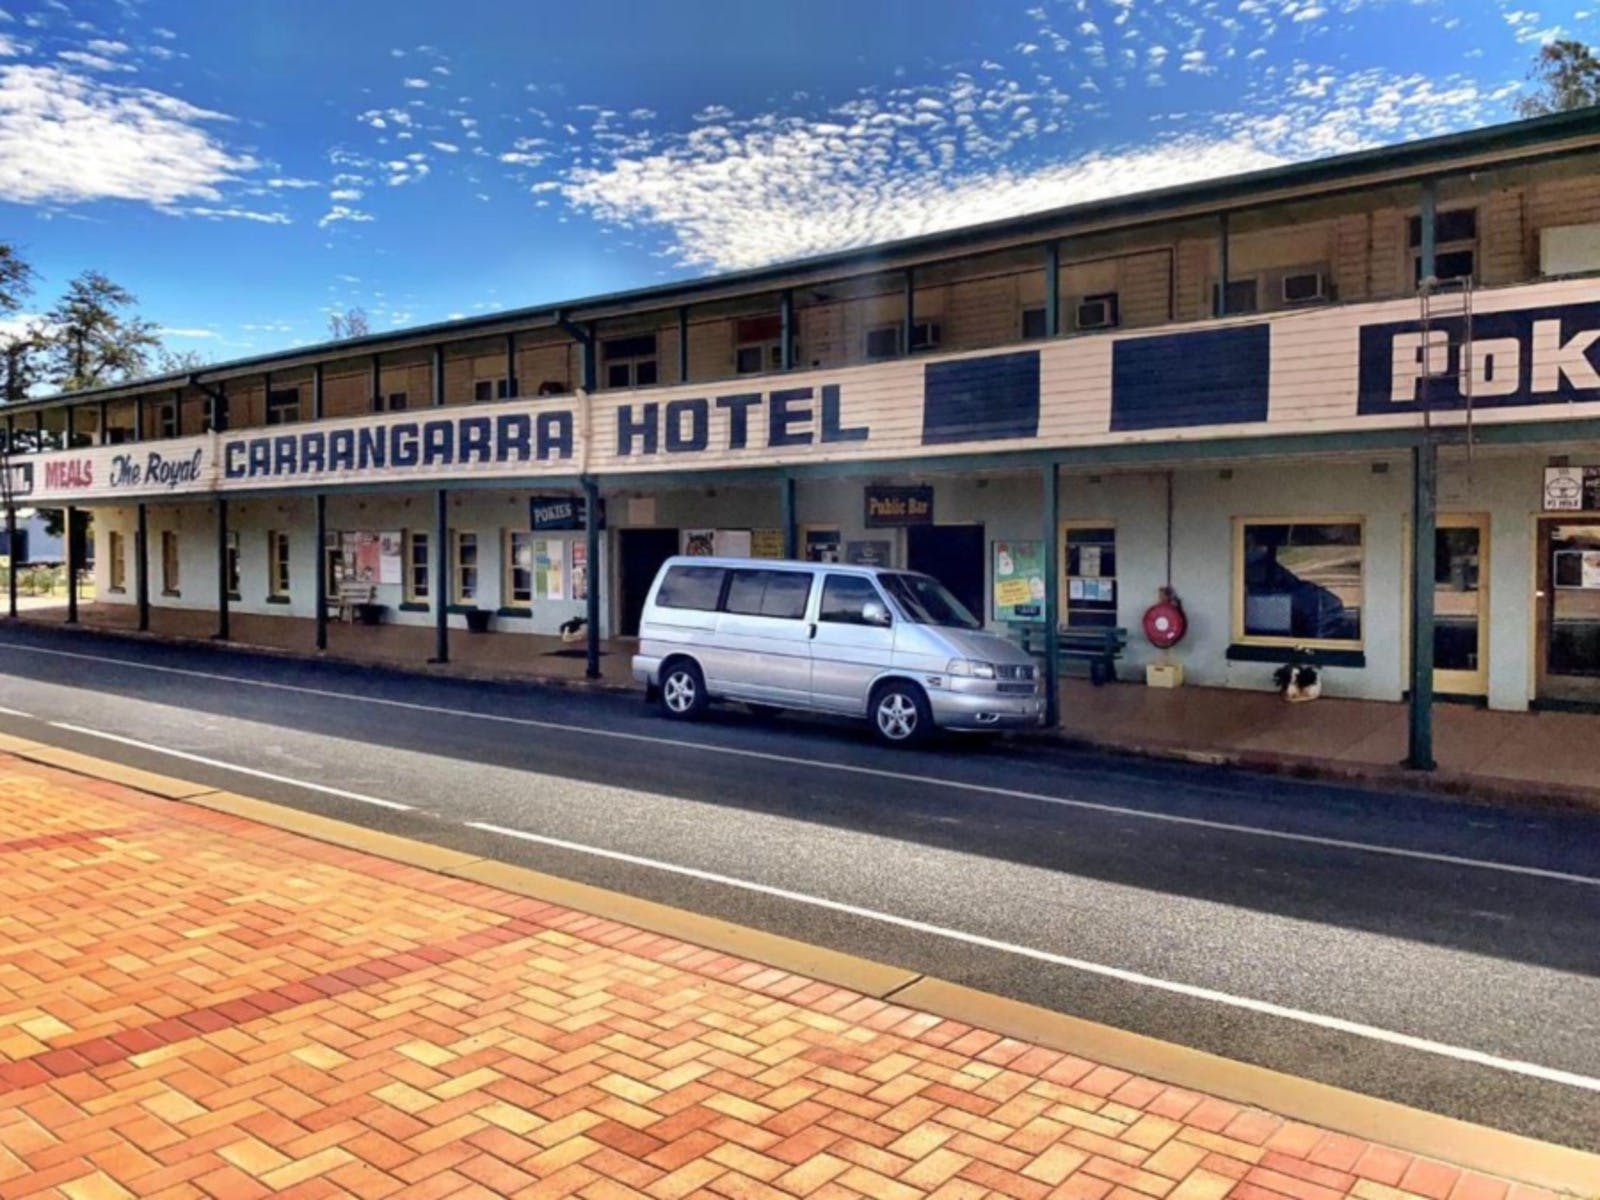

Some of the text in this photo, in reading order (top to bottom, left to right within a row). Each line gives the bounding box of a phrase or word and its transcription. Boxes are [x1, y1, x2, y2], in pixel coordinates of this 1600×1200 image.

[110, 384, 869, 489] The Royal CARRANGARRA HOTEL
[45, 459, 93, 490] MEALS
[870, 497, 928, 515] Public Bar
